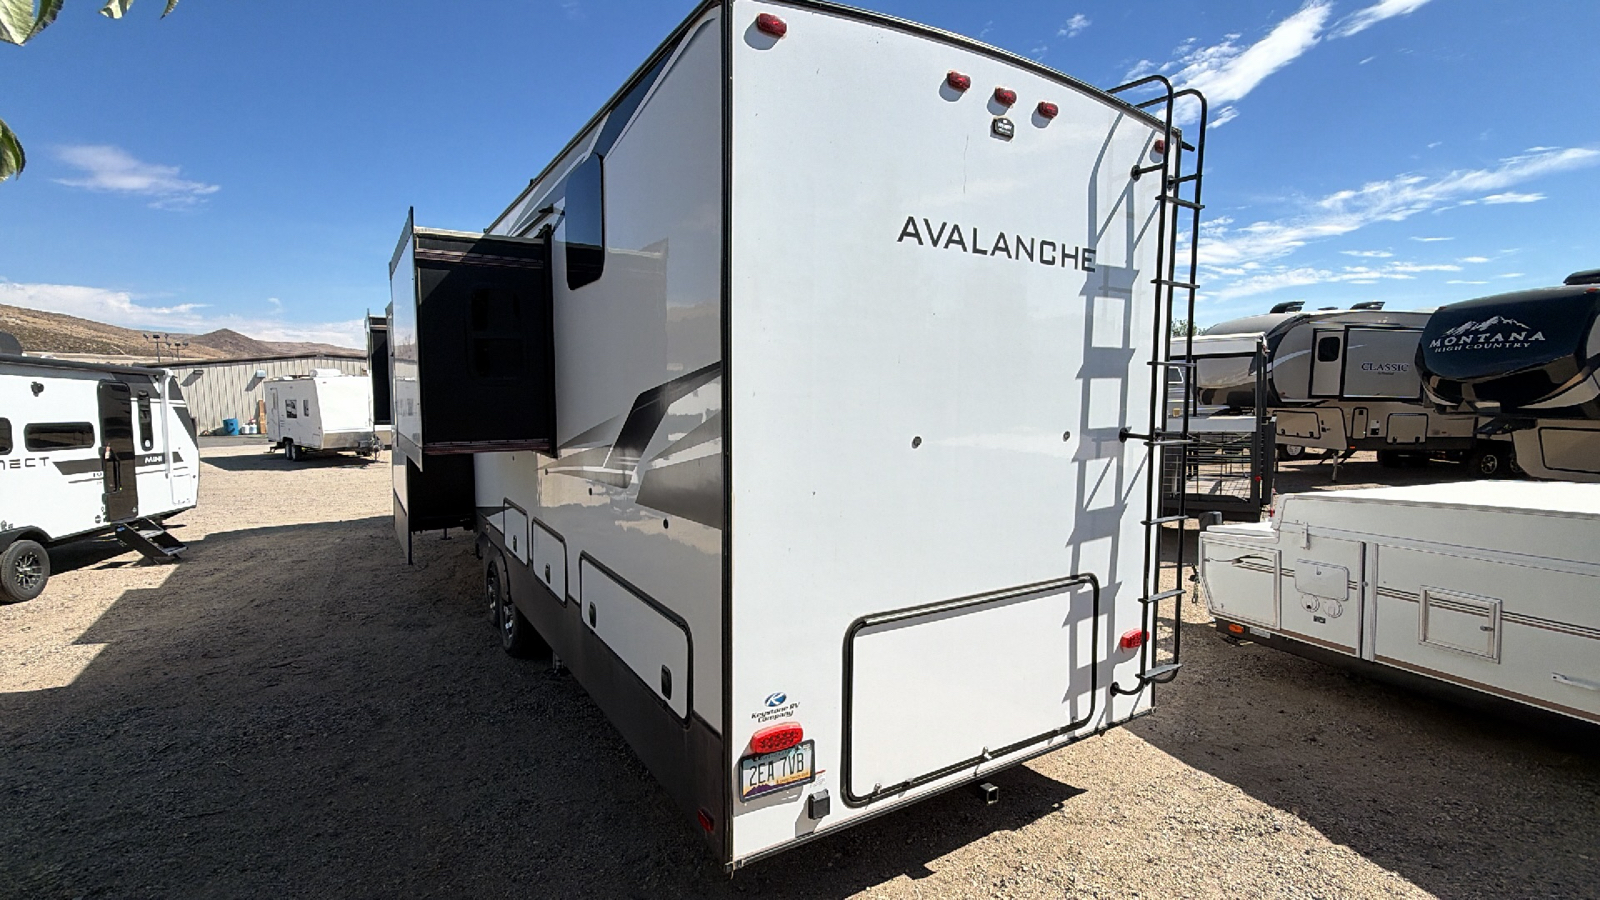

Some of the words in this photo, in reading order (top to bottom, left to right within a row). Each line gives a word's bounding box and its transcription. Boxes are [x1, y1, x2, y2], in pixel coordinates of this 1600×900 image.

[897, 216, 1096, 273] AVALANCHE
[1429, 331, 1546, 349] MONTANA
[1435, 345, 1462, 353] HIGH
[1465, 342, 1531, 350] COUNTRY
[1361, 362, 1409, 372] CLASSIC
[751, 706, 789, 719] Keystone
[789, 701, 801, 710] RV
[757, 710, 794, 723] Company
[749, 761, 775, 787] 2EA
[780, 753, 804, 777] 7VB
